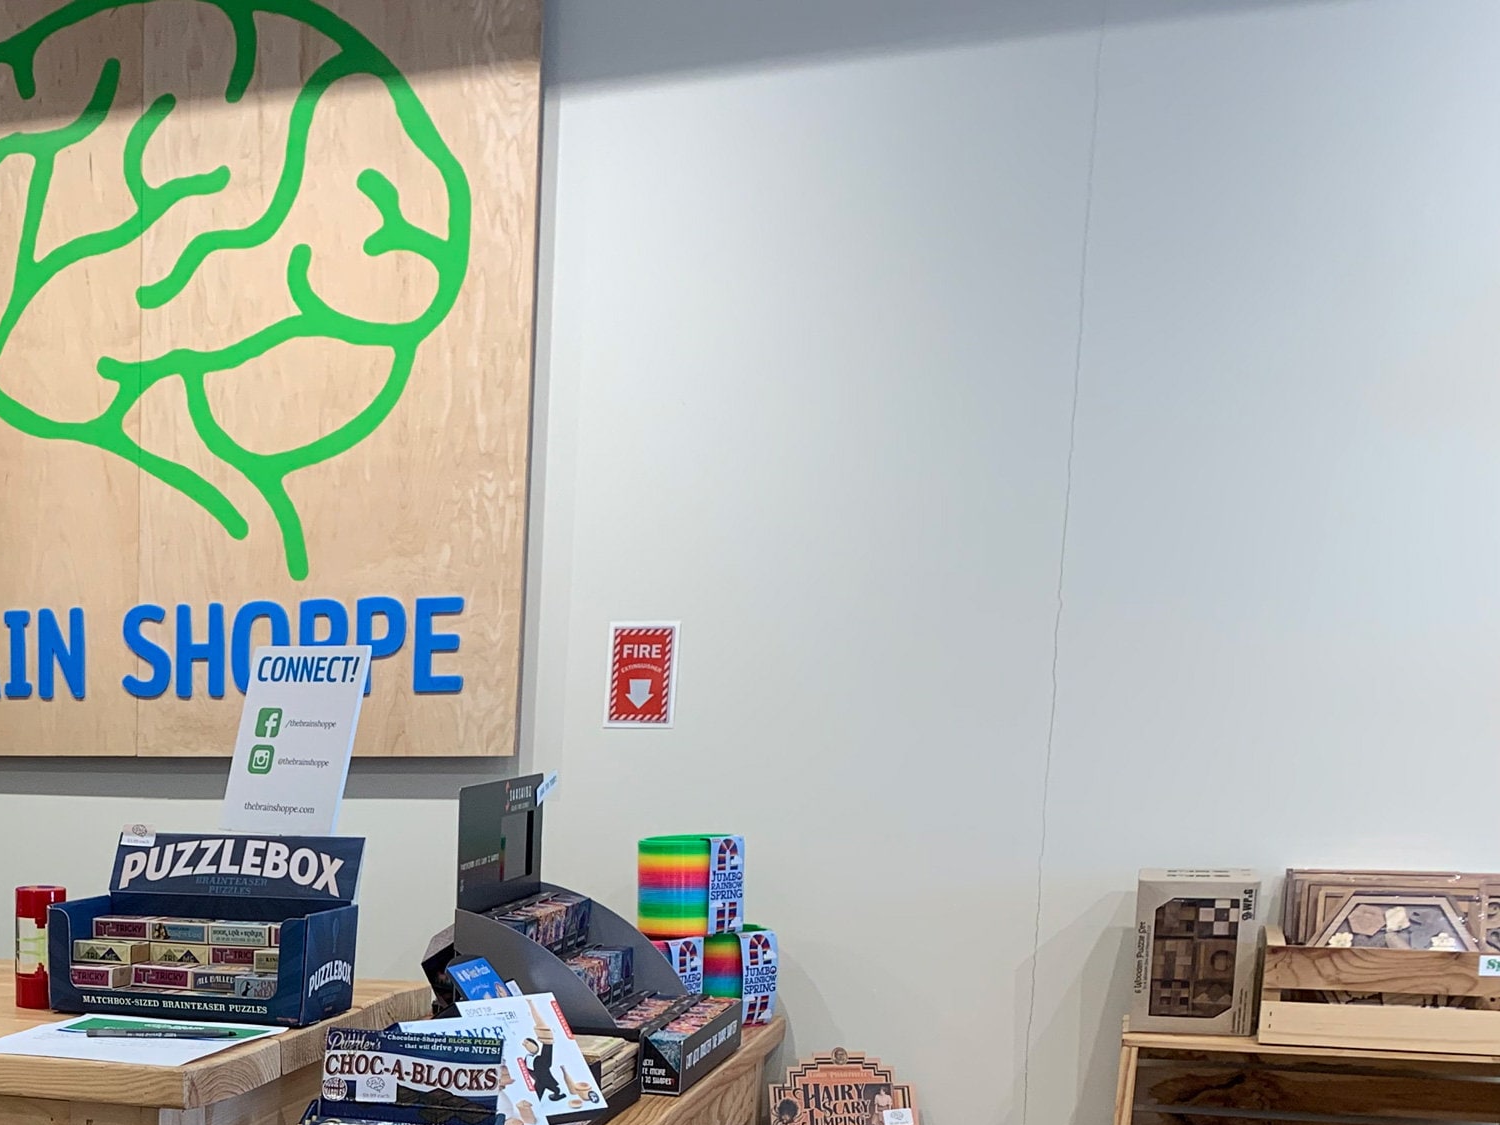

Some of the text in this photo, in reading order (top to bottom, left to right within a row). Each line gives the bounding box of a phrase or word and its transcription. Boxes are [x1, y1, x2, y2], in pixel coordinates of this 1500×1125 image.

[622, 644, 663, 659] FIRE
[257, 656, 360, 683] CONNECT!
[620, 662, 663, 674] EXTINGUISHER
[284, 718, 337, 730] /thebrainshoppe
[277, 757, 330, 769] @thebrainshoppe
[244, 802, 315, 816] thebrainshoppe.com
[118, 837, 345, 898] PUZZLEBOX
[195, 876, 268, 888] BRAINTEASER
[711, 871, 743, 882] JUMBO
[208, 885, 251, 895] PUZZLES
[711, 881, 743, 890] RAINBOW
[710, 889, 743, 900] SPRING
[116, 924, 143, 933] TRICKY
[156, 971, 184, 981] TRICKY
[744, 965, 777, 977] JUMBO
[308, 960, 352, 997] PUZZLEBOX
[744, 975, 777, 985] RAINBOW
[743, 984, 777, 995] SPRING
[82, 995, 268, 1015] MATCHBOX-SIZED BRAINTEASER PUZZLES
[328, 1031, 501, 1051] Puzzler's Chocolate-Shaped BLOCK PUZZLE
[418, 1043, 430, 1051] will
[431, 1043, 452, 1052] drive
[453, 1046, 470, 1054] you
[471, 1046, 501, 1055] NUTS!
[325, 1052, 498, 1091] CHOC-A-BLOCKS
[796, 1083, 864, 1111] HAIRY
[821, 1100, 871, 1118] SCARY
